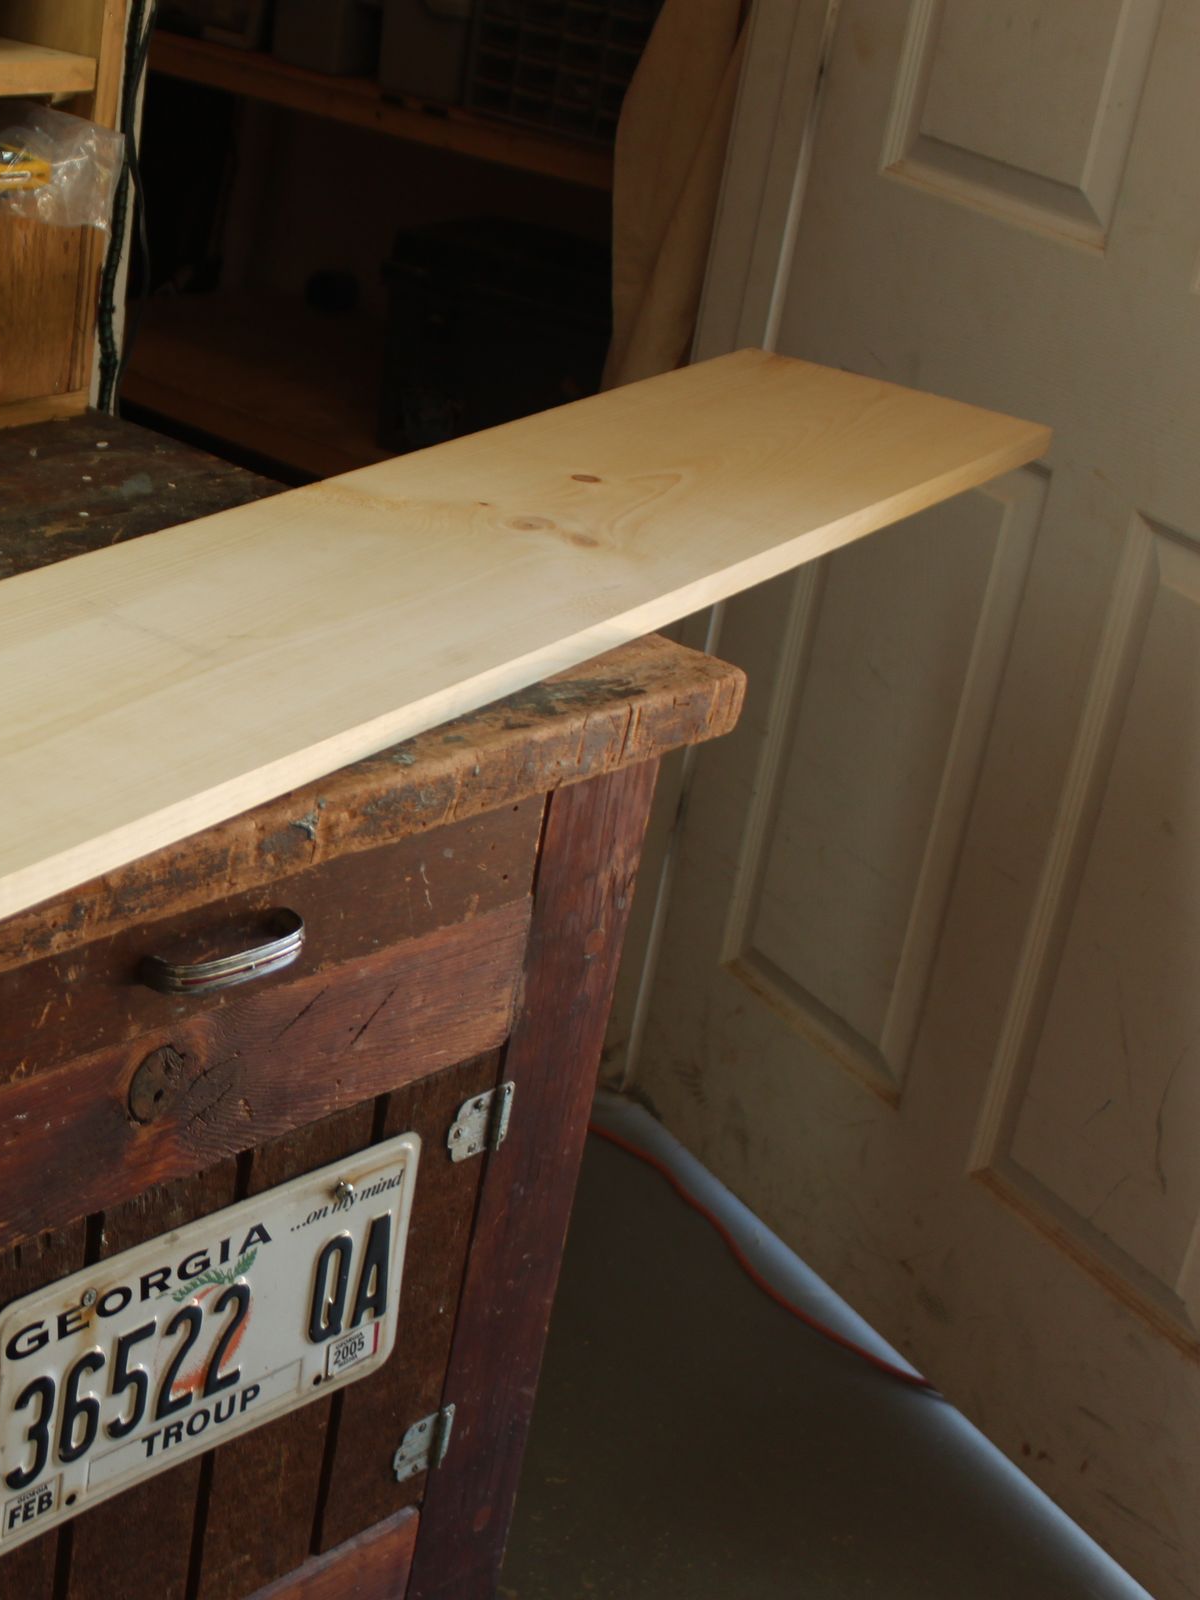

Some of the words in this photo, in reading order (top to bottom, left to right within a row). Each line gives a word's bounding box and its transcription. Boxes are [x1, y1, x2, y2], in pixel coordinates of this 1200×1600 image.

[331, 1192, 358, 1215] my
[359, 1168, 404, 1202] mind
[5, 1222, 272, 1361] GEORGIA
[5, 1283, 252, 1490] 36522
[308, 1213, 391, 1343] QA
[333, 1338, 365, 1366] 2005
[141, 1383, 261, 1458] TROUP
[8, 1491, 53, 1530] FEB
